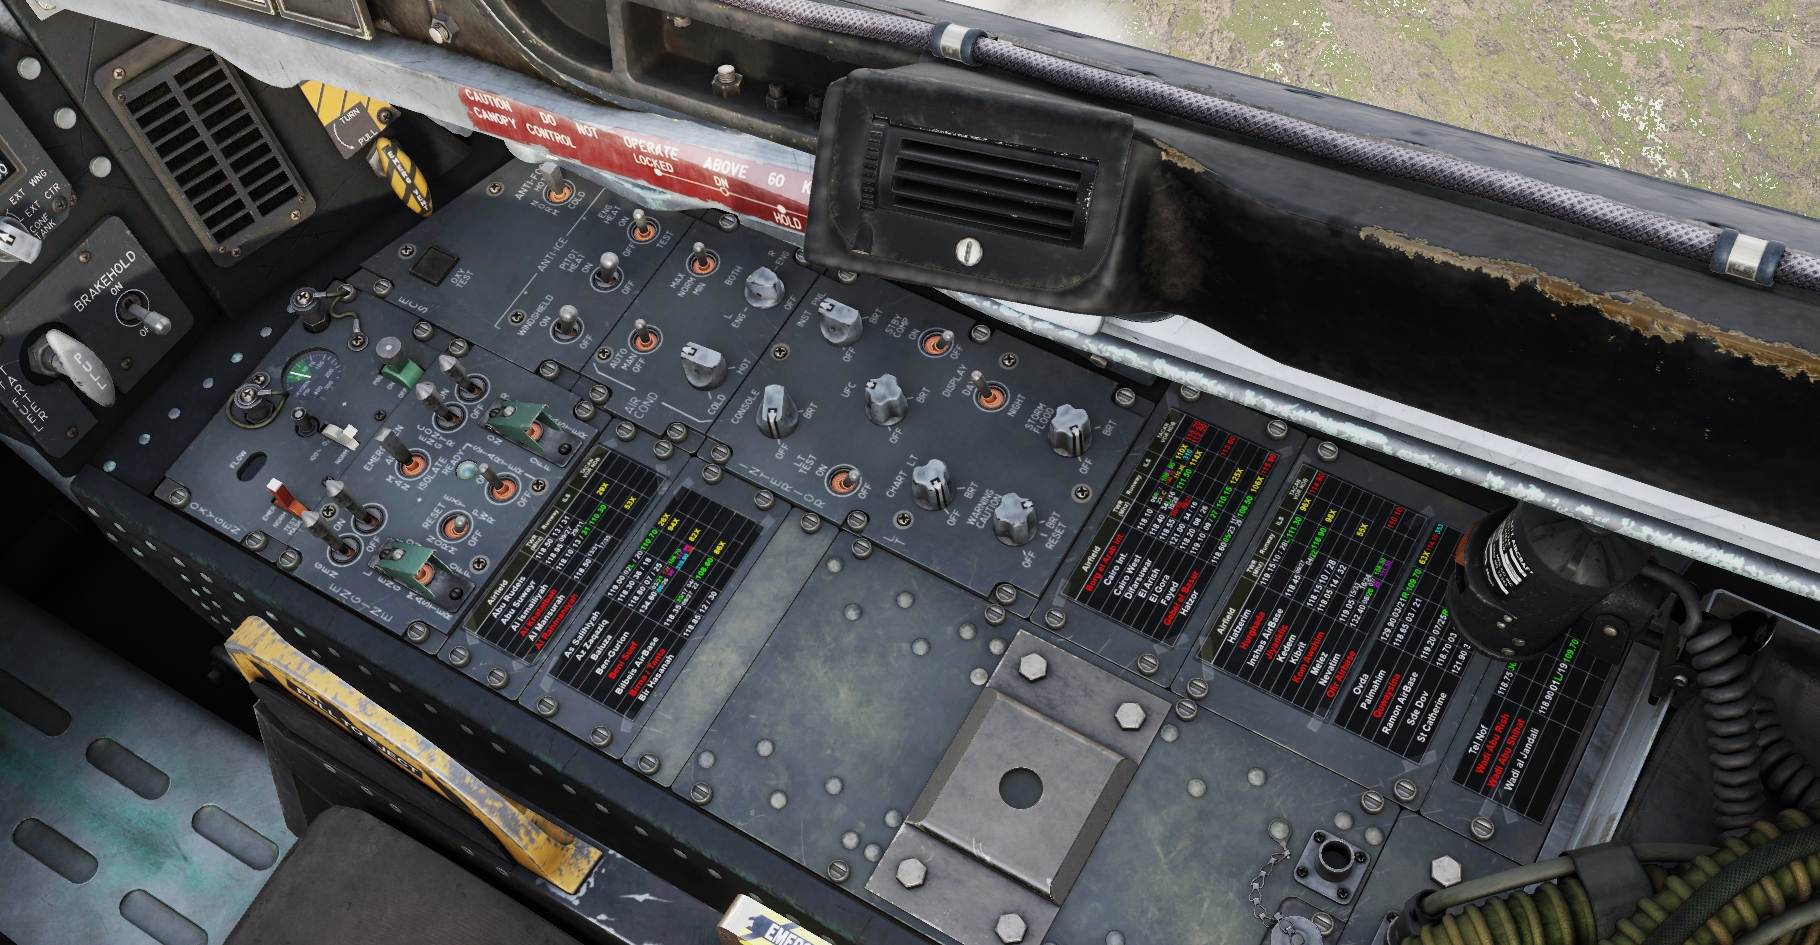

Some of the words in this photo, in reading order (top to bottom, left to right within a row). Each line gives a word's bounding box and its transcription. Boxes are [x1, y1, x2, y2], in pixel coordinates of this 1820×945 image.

[339, 107, 361, 124] TURN
[358, 129, 378, 146] PULL
[464, 88, 513, 113] CAUTION
[539, 111, 557, 127] DO
[576, 122, 598, 139] NOT
[623, 136, 679, 161] OPERATE
[703, 156, 749, 180] ABOVE
[767, 171, 785, 188] 60
[473, 106, 516, 130] CANOPY
[526, 122, 577, 149] CONTROL
[633, 152, 674, 174] LOCKED
[772, 211, 802, 230] HOLD
[9, 188, 26, 206] EXT
[28, 169, 47, 187] WNG
[387, 150, 412, 184] EMERG
[412, 189, 429, 211] VENT
[24, 200, 41, 218] EXT
[44, 182, 61, 200] CTR
[530, 200, 561, 217] NORM
[567, 190, 586, 210] COLD
[597, 203, 613, 219] ENG
[29, 212, 49, 233] CONF
[604, 205, 622, 225] HEAT
[617, 215, 629, 228] ON
[34, 219, 57, 240] TANK
[655, 230, 674, 249] TEST
[537, 236, 568, 273] ANTI-ICE
[559, 248, 577, 271] PITOT
[622, 242, 637, 258] OFF
[567, 253, 586, 274] HEAT
[581, 262, 594, 274] ON
[73, 250, 137, 312] BRAKEHOLD
[450, 267, 465, 284] OXY
[456, 269, 474, 289] TEST
[669, 272, 687, 289] MAX
[724, 265, 743, 286] BOTH
[110, 281, 124, 296] ON
[621, 279, 635, 295] OFF
[677, 276, 697, 298] NORM
[692, 282, 707, 296] MIN
[398, 296, 429, 314] ECS
[783, 295, 797, 311] OFF
[796, 310, 812, 328] INST
[811, 292, 827, 307] PNL
[517, 294, 554, 337] WINDSHIELD
[539, 315, 552, 328] ON
[731, 312, 747, 329] ENG
[868, 307, 883, 325] BRT
[885, 314, 904, 334] STBY
[893, 317, 909, 338] COMP
[908, 328, 920, 340] ON
[579, 334, 594, 350] OFF
[949, 343, 964, 360] OFF
[609, 347, 628, 369] AUTO
[620, 353, 637, 371] MAN
[632, 357, 646, 373] OFF
[842, 346, 856, 363] OFF
[73, 352, 107, 390] PULL
[736, 358, 752, 375] HOT
[841, 381, 857, 399] UFC
[941, 363, 968, 398] DISPLAY
[624, 396, 640, 415] AIR
[633, 391, 658, 419] COND
[707, 393, 726, 415] COLD
[731, 388, 761, 425] CONSOLE
[915, 387, 932, 404] BRT
[1006, 393, 1027, 418] NIGHT
[11, 397, 43, 433] FUEL
[470, 403, 485, 420] OFF
[803, 402, 819, 420] BRT
[1024, 402, 1047, 431] STORM
[1032, 406, 1055, 434] FLOOD
[417, 424, 456, 447] CONTR
[889, 426, 904, 444] OFF
[1101, 419, 1117, 437] BRT
[418, 434, 443, 450] ENG
[774, 443, 789, 460] OFF
[229, 450, 247, 469] FLOW
[441, 448, 465, 476] READY
[474, 444, 525, 476] STARTER
[798, 453, 818, 475] TEST
[815, 463, 829, 477] ON
[1078, 456, 1093, 475] OFF
[385, 474, 411, 491] MAN
[417, 456, 448, 491] ISOLATE
[885, 470, 908, 499] CHART
[906, 453, 919, 468] LT
[739, 462, 826, 509] INTERIOR
[857, 482, 872, 500] OFF
[963, 481, 980, 500] BRT
[442, 493, 467, 508] EXT
[517, 491, 533, 509] OFF
[966, 488, 995, 527] WARNING
[189, 501, 242, 535] OXYGEN
[421, 501, 446, 530] RESET
[946, 508, 962, 527] OFF
[975, 493, 1004, 530] CAUTION
[1045, 510, 1062, 529] BRT
[333, 517, 347, 532] ON
[365, 535, 382, 553] OFF
[426, 534, 458, 555] NORM
[467, 529, 484, 548] OFF
[1044, 522, 1067, 551] RESET
[314, 560, 340, 580] GEN
[1021, 550, 1037, 569] OFF
[1081, 545, 1102, 573] Airfield
[1103, 566, 1120, 586] Cairo
[1113, 575, 1130, 596] Cairo
[1125, 554, 1142, 575] West
[1143, 567, 1161, 589] Arish
[1154, 574, 1171, 594] Gora
[328, 582, 393, 623] ENGINE
[491, 602, 506, 619] Abu
[503, 575, 526, 602] Rudeis
[500, 608, 516, 625] Abu
[512, 579, 536, 608] Suwayr
[1160, 580, 1180, 606] Fayed
[1179, 589, 1199, 616] Hatzor
[405, 592, 453, 622] MASTER
[535, 594, 566, 632] Mansurah
[583, 618, 610, 650] Zaqaziq
[1227, 608, 1252, 644] Hatzerim
[1381, 617, 1397, 642] 129.90
[589, 634, 613, 662] Baluza
[1246, 639, 1267, 667] Inshas
[1262, 608, 1284, 640] AirBase
[1276, 634, 1297, 663] Kedem
[1420, 636, 1437, 659] 119.20
[595, 630, 630, 676] Ben-Gurion
[1288, 641, 1307, 665] Kibrit
[1310, 651, 1329, 676] Melez
[1436, 643, 1452, 667] 118.70
[1451, 650, 1468, 674] 121.90
[614, 667, 638, 695] Bilbeis
[634, 636, 660, 668] AirBase
[646, 654, 675, 689] Hasanah
[1318, 653, 1341, 687] Nevatim
[1352, 673, 1370, 695] Ovda
[1360, 669, 1387, 710] Palmahim
[1497, 671, 1514, 695] 118.75
[1381, 702, 1403, 735] Ramon
[1397, 671, 1419, 705] AirBase
[1406, 708, 1421, 726] Sde
[1416, 690, 1429, 709] Dov
[1422, 691, 1447, 732] Catherine
[296, 687, 338, 719] PULL
[366, 736, 419, 773] EJECT
[1477, 724, 1489, 742] Nof
[1522, 727, 1540, 760] Jandali
